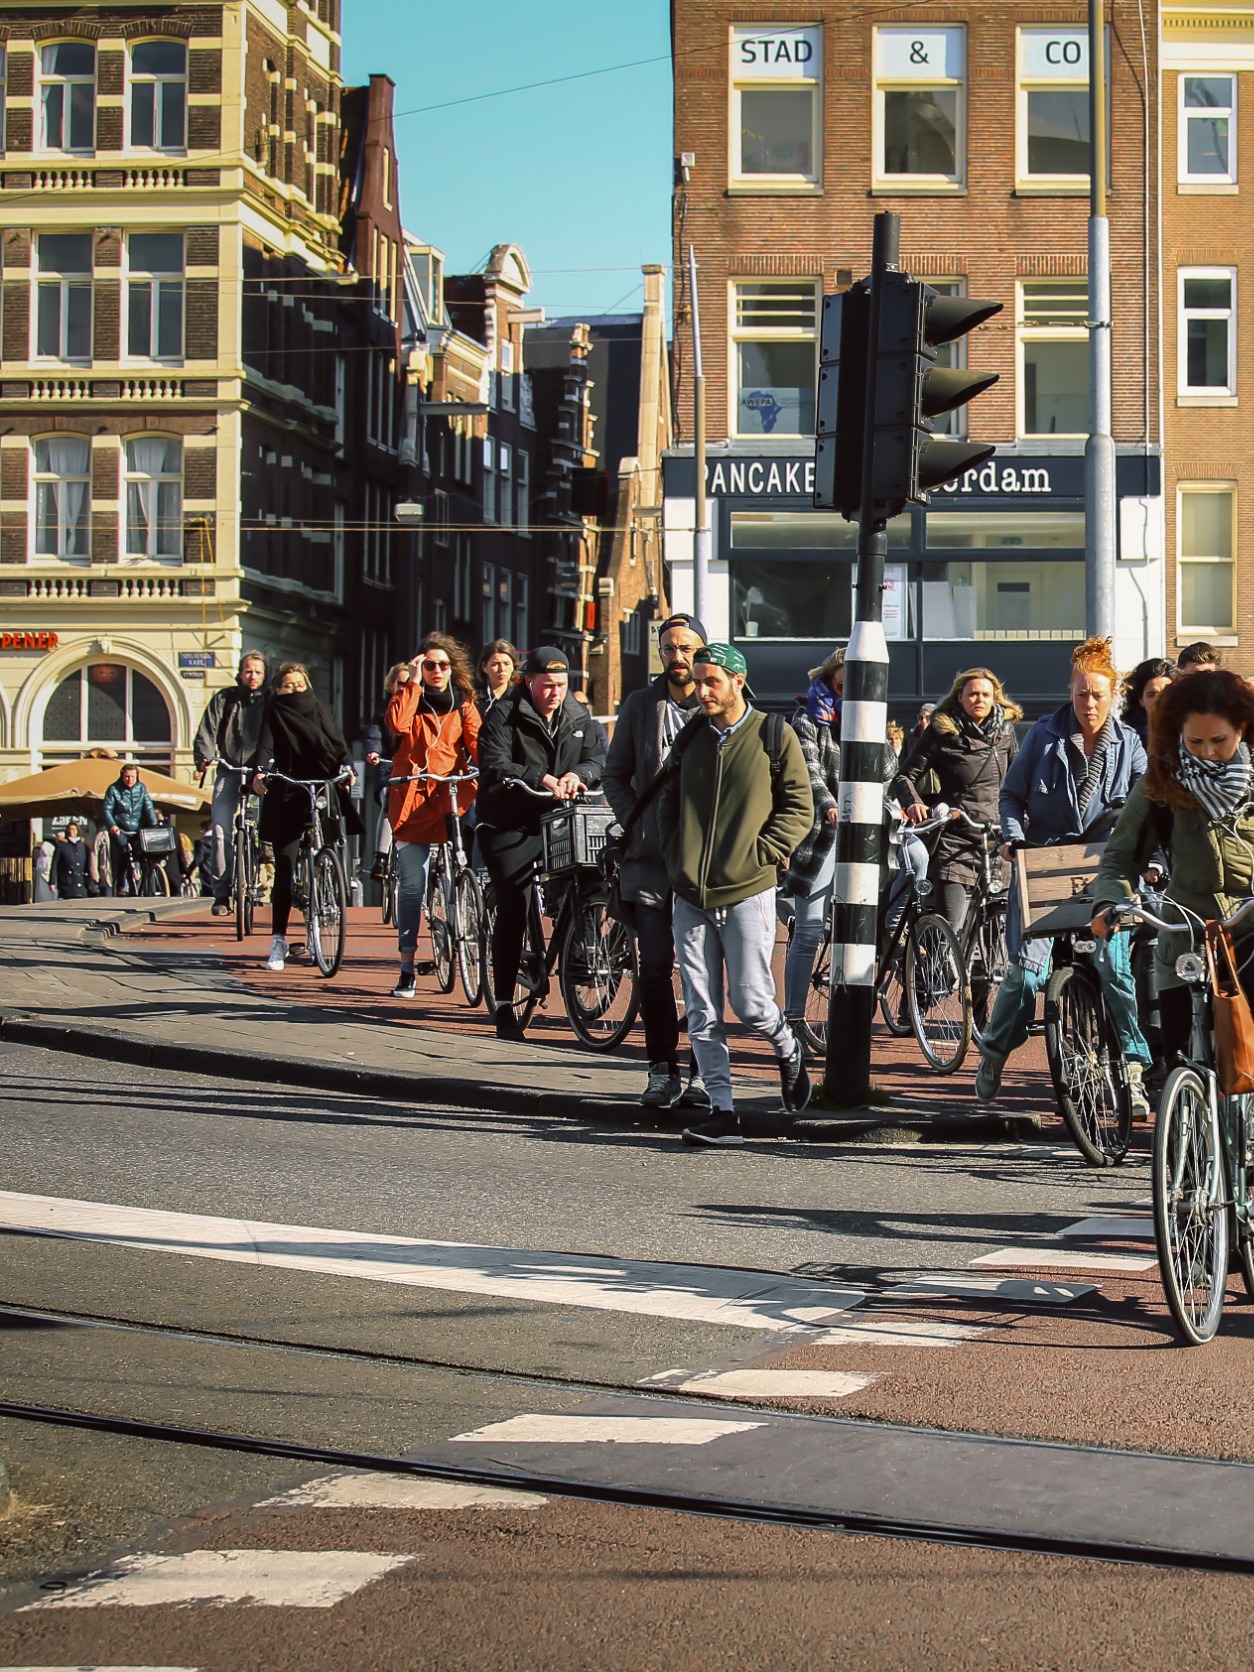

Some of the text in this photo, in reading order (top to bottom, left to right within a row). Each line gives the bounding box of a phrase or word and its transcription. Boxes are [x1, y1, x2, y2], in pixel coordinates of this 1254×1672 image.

[741, 40, 1082, 64] STAD & CO
[741, 398, 772, 406] AWEPA
[1, 631, 59, 649] PENER
